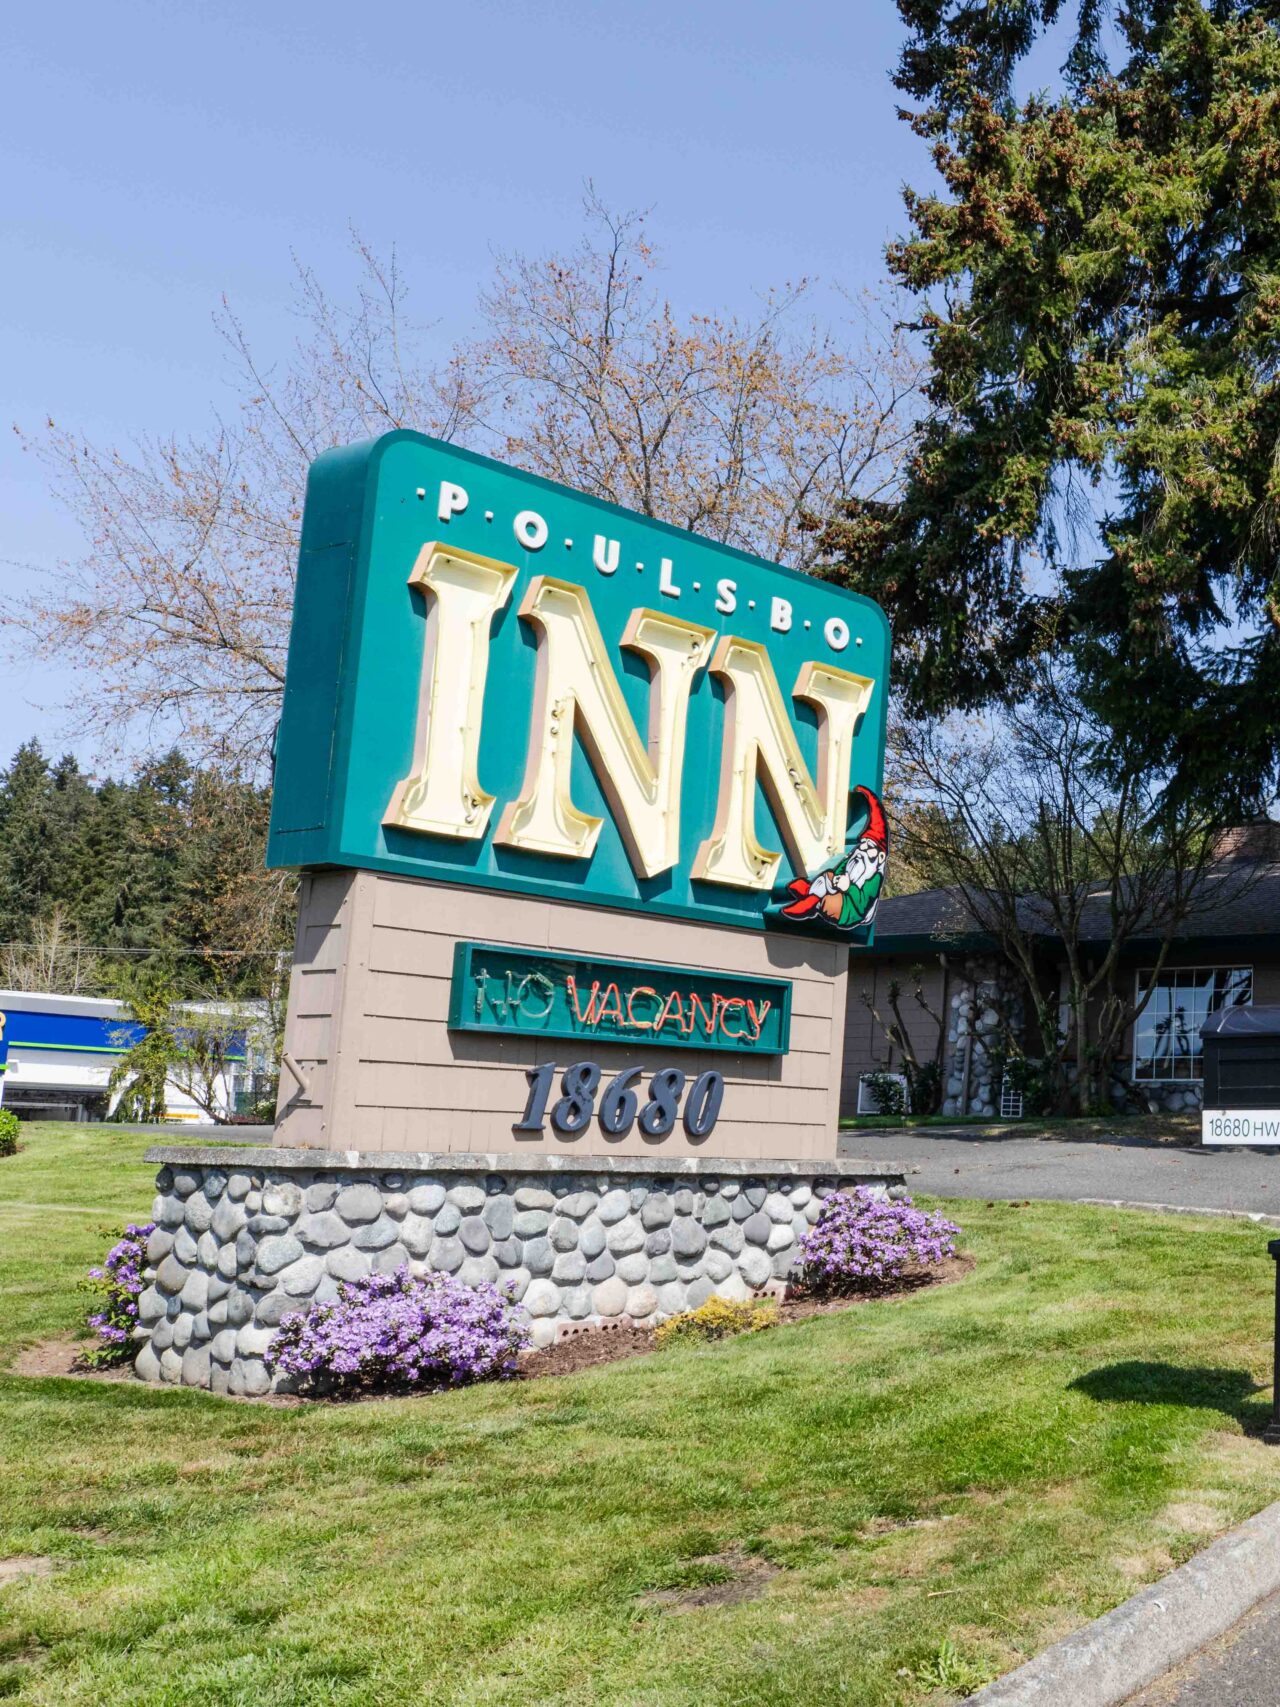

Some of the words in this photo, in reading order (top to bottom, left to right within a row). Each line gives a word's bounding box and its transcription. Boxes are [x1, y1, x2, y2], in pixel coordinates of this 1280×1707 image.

[437, 480, 851, 651] POULSBO
[381, 541, 876, 891] INN
[567, 975, 772, 1041] VACANCY
[512, 1061, 725, 1137] 18680
[1209, 1118, 1251, 1137] 18680
